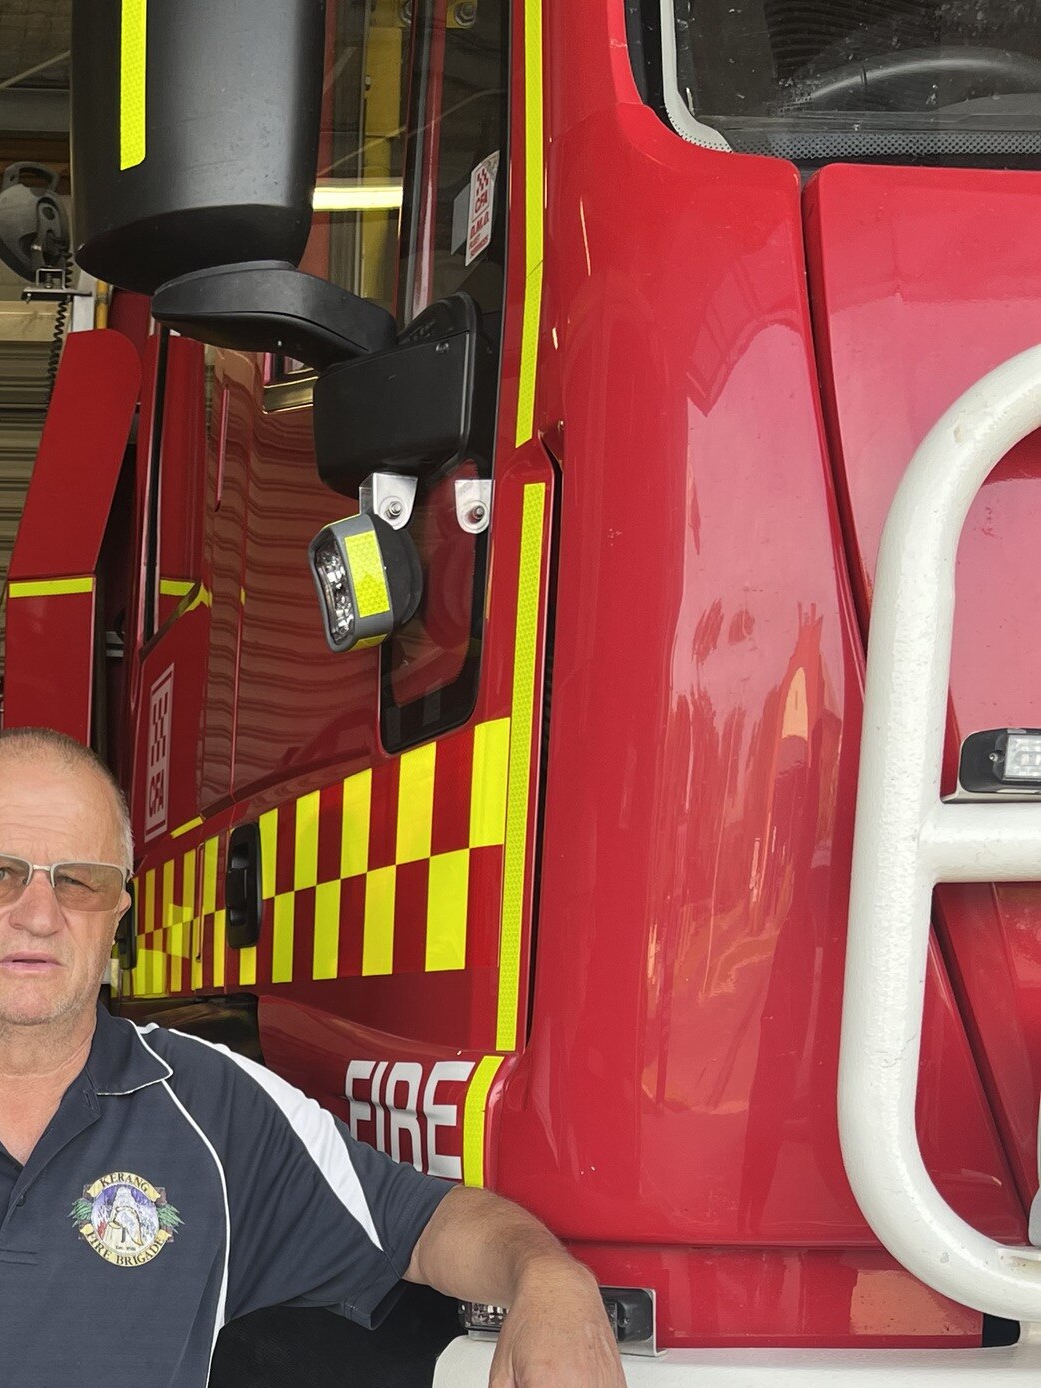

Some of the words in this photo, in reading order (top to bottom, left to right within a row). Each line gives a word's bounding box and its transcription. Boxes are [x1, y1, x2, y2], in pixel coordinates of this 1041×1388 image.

[474, 189, 488, 214] CFA
[149, 768, 165, 818] CFA
[345, 1059, 476, 1180] FIRE
[100, 1172, 149, 1193] KERANG
[86, 1230, 110, 1260] FIRE
[116, 1237, 165, 1266] BRIGADE
